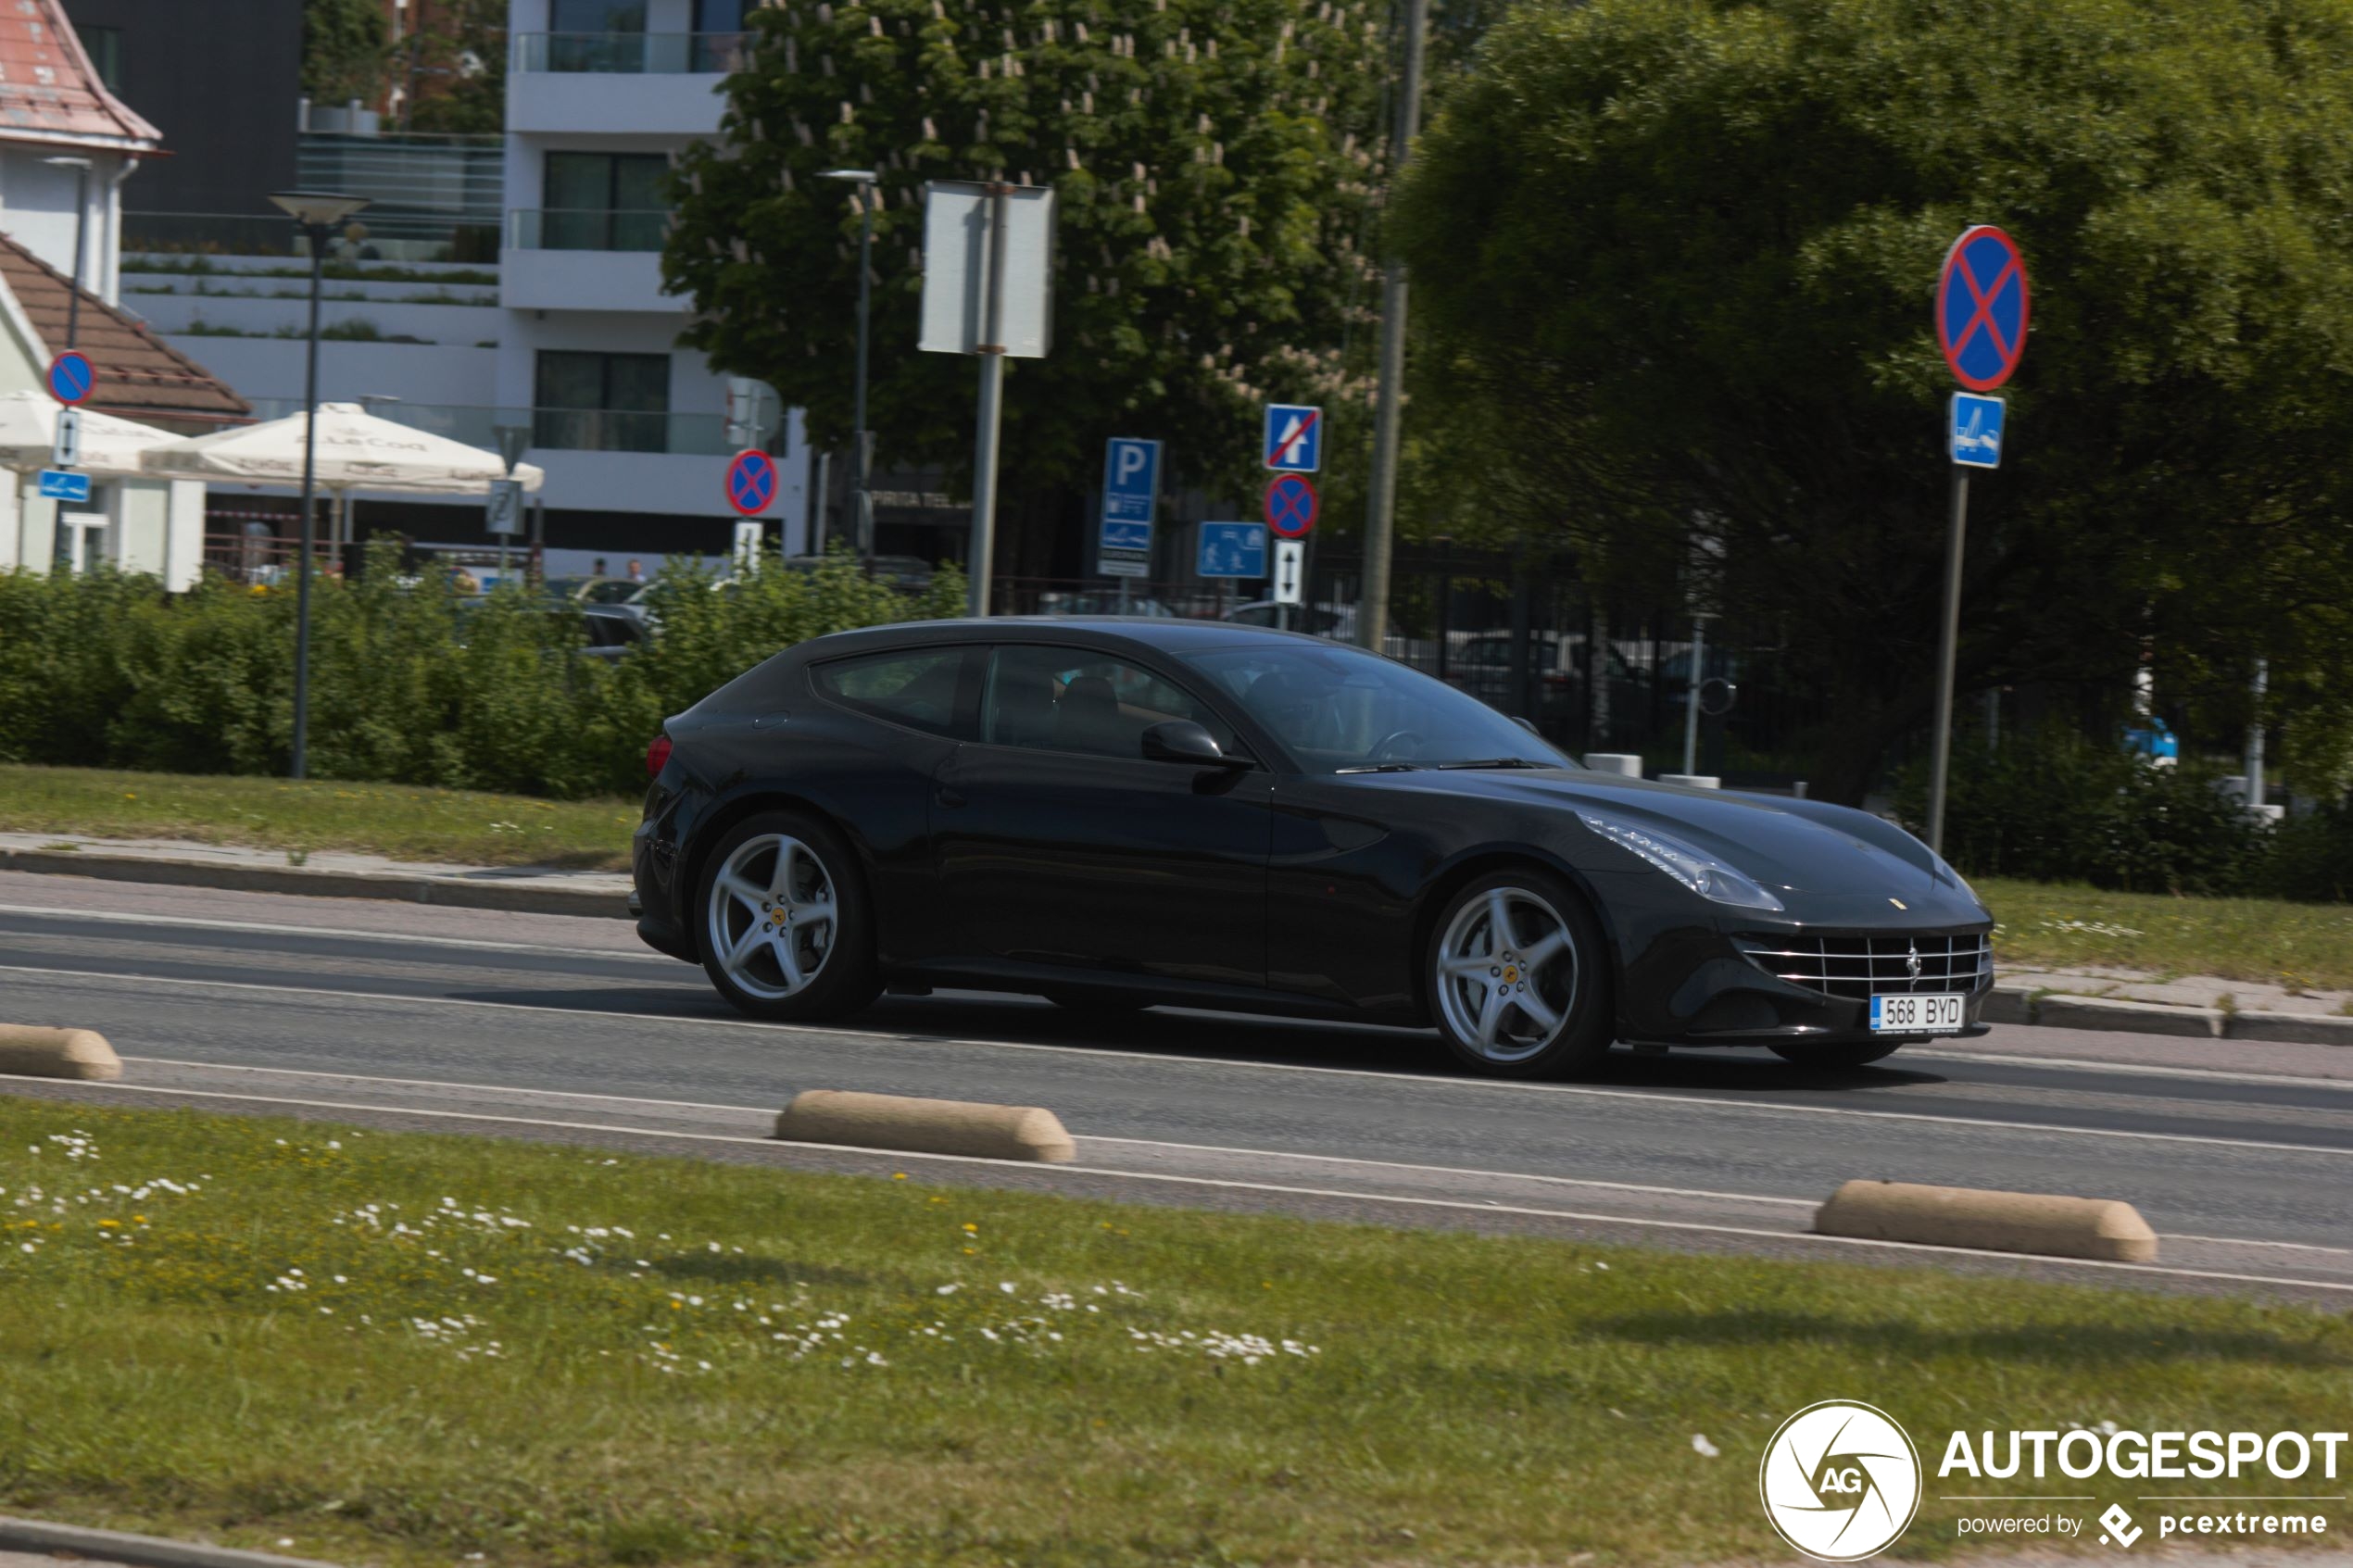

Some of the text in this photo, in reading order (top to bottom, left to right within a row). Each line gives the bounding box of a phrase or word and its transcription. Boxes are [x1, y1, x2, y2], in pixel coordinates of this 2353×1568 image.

[1116, 444, 1146, 485] P
[1886, 998, 1959, 1024] 568 BYD
